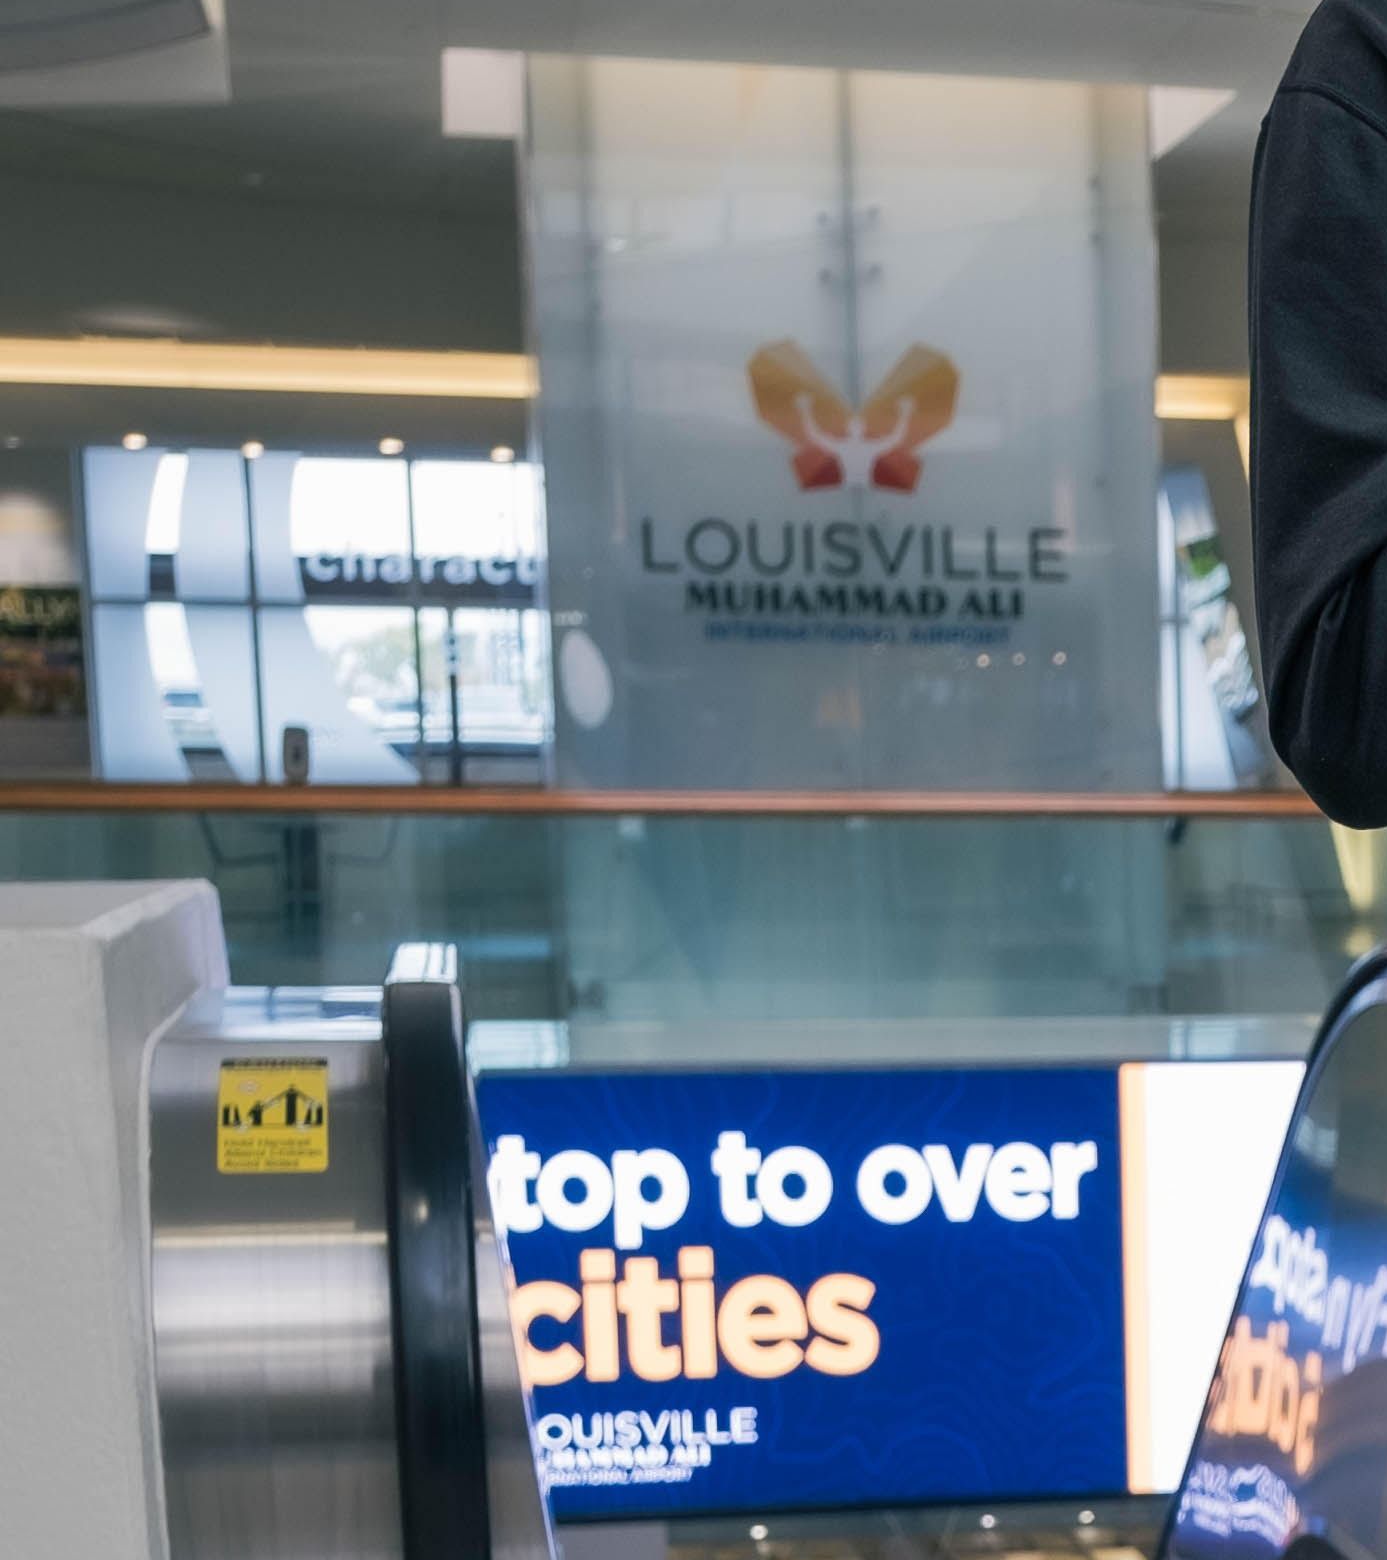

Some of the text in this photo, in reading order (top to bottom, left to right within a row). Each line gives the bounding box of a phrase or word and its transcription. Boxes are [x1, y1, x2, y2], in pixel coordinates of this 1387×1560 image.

[639, 516, 1070, 584] LOUISVILLE
[684, 580, 1025, 619] MUHAMMAD ALI
[711, 1130, 834, 1228] to
[856, 1140, 1098, 1225] over
[510, 1245, 880, 1387] cities
